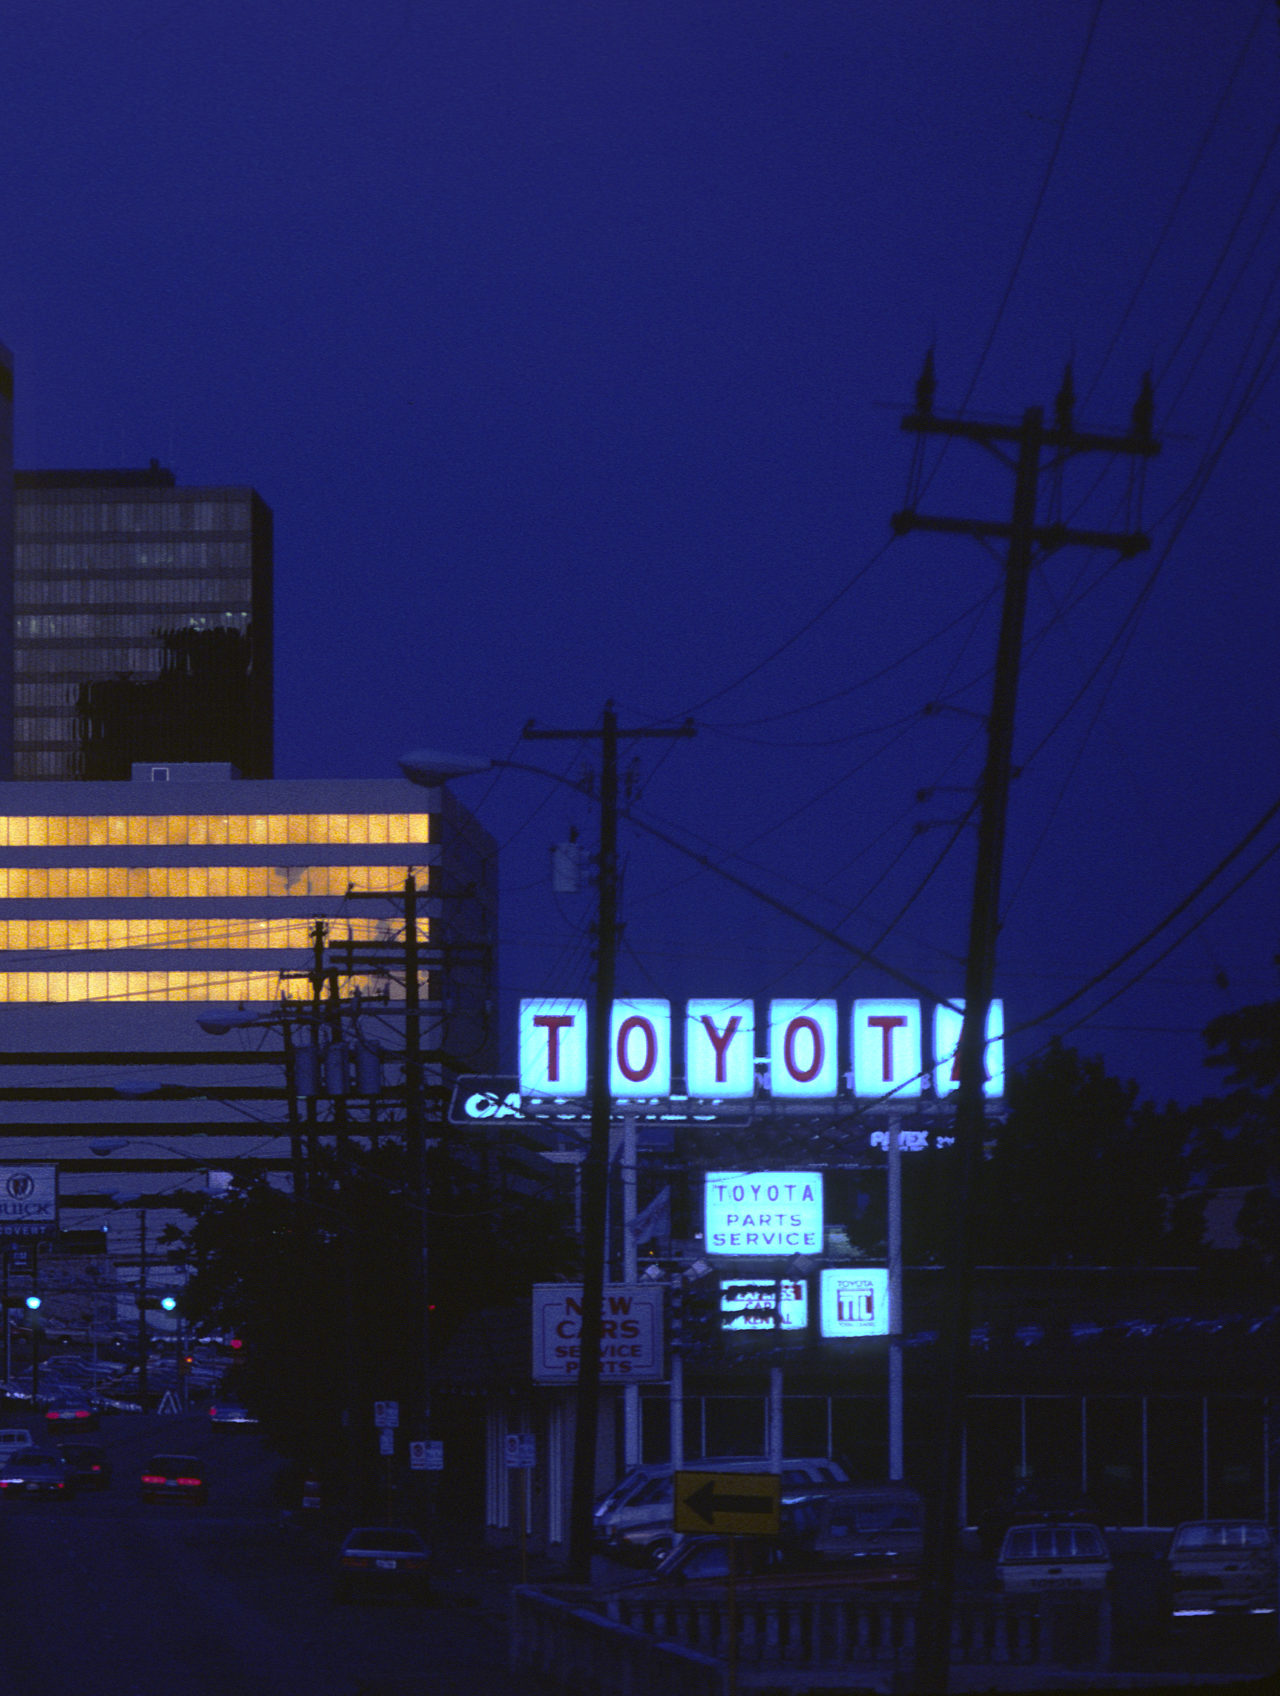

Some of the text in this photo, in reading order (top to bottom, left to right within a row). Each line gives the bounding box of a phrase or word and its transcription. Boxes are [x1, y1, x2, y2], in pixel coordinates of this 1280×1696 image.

[714, 1184, 815, 1202] TOYOTA
[727, 1214, 802, 1227] PARTS
[713, 1232, 816, 1246] SERVICE
[837, 1280, 874, 1288] TOYOTA
[565, 1297, 632, 1315] NW
[556, 1320, 639, 1339] CRS
[555, 1345, 642, 1358] SEVICE
[566, 1361, 632, 1373] PTS
